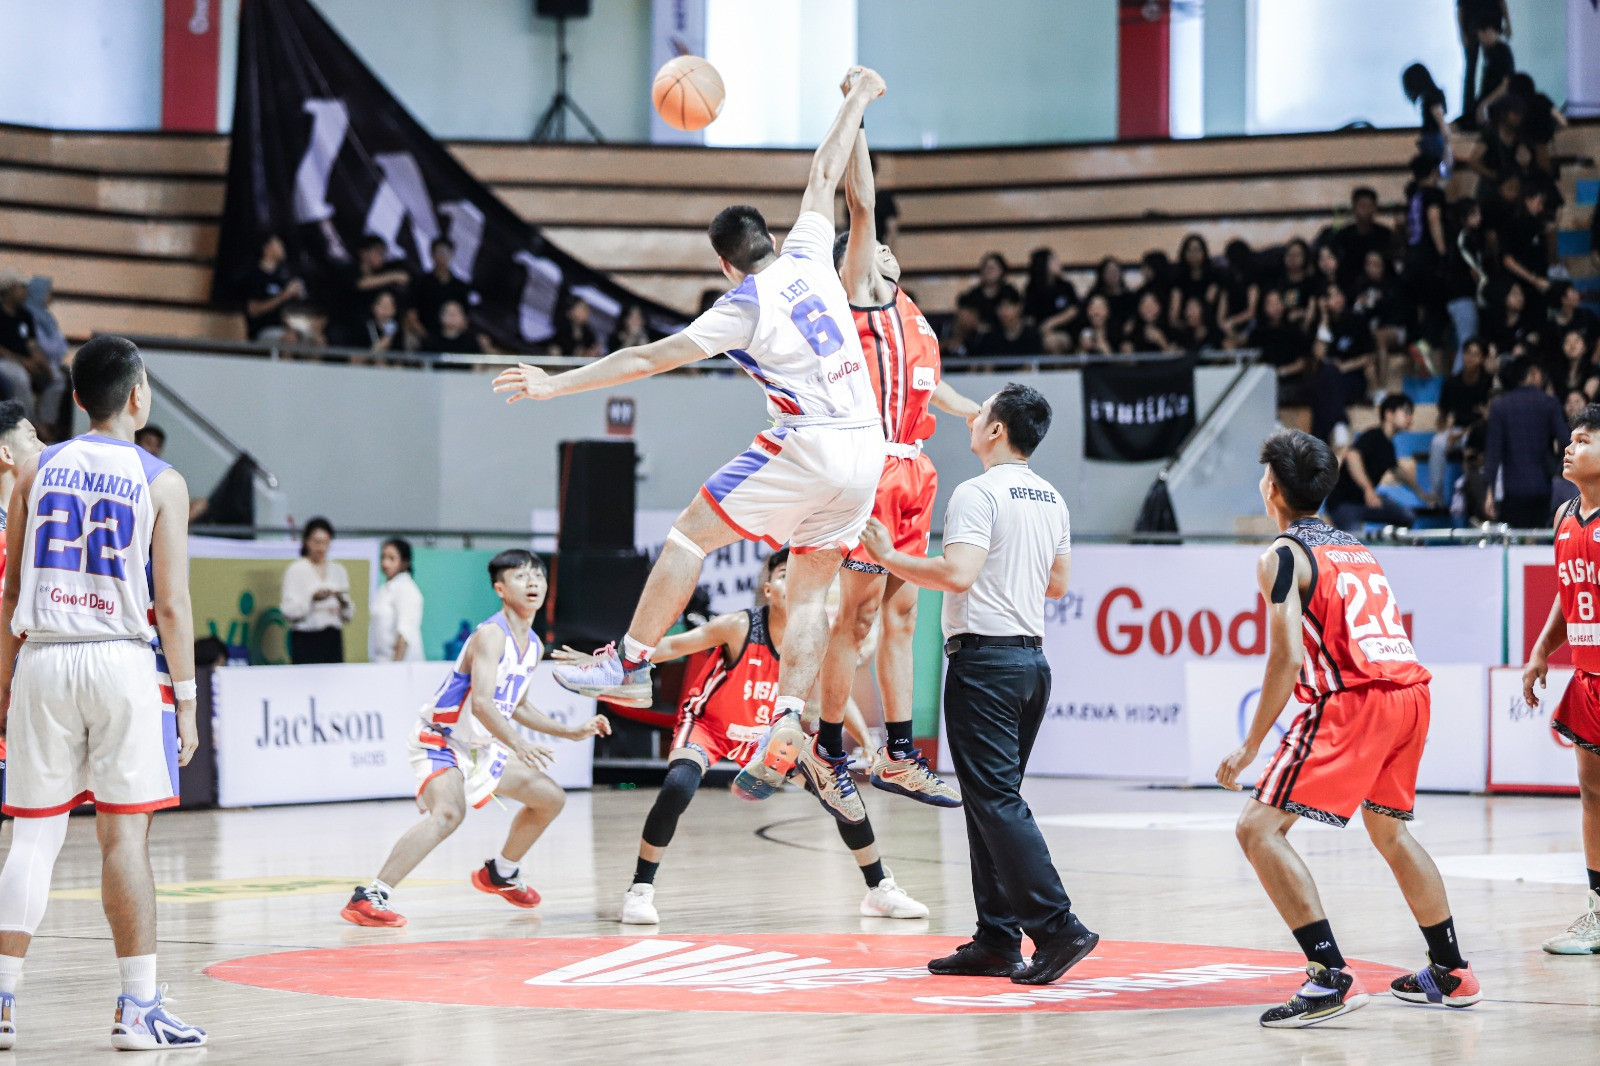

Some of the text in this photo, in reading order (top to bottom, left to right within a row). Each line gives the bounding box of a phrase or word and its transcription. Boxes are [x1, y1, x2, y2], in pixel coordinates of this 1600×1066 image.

[780, 279, 810, 303] LEO
[791, 294, 845, 358] 6
[844, 361, 861, 375] Da
[42, 467, 142, 503] KHANANDA
[1009, 486, 1057, 504] REFEREE
[34, 491, 135, 582] 22
[1325, 549, 1377, 565] BINTANG
[1558, 557, 1600, 586] SISM
[1336, 571, 1408, 639] 22
[1577, 591, 1595, 621] 8
[1044, 586, 1267, 657] OPI Good
[255, 695, 385, 749] Jackson
[754, 704, 770, 725] 9
